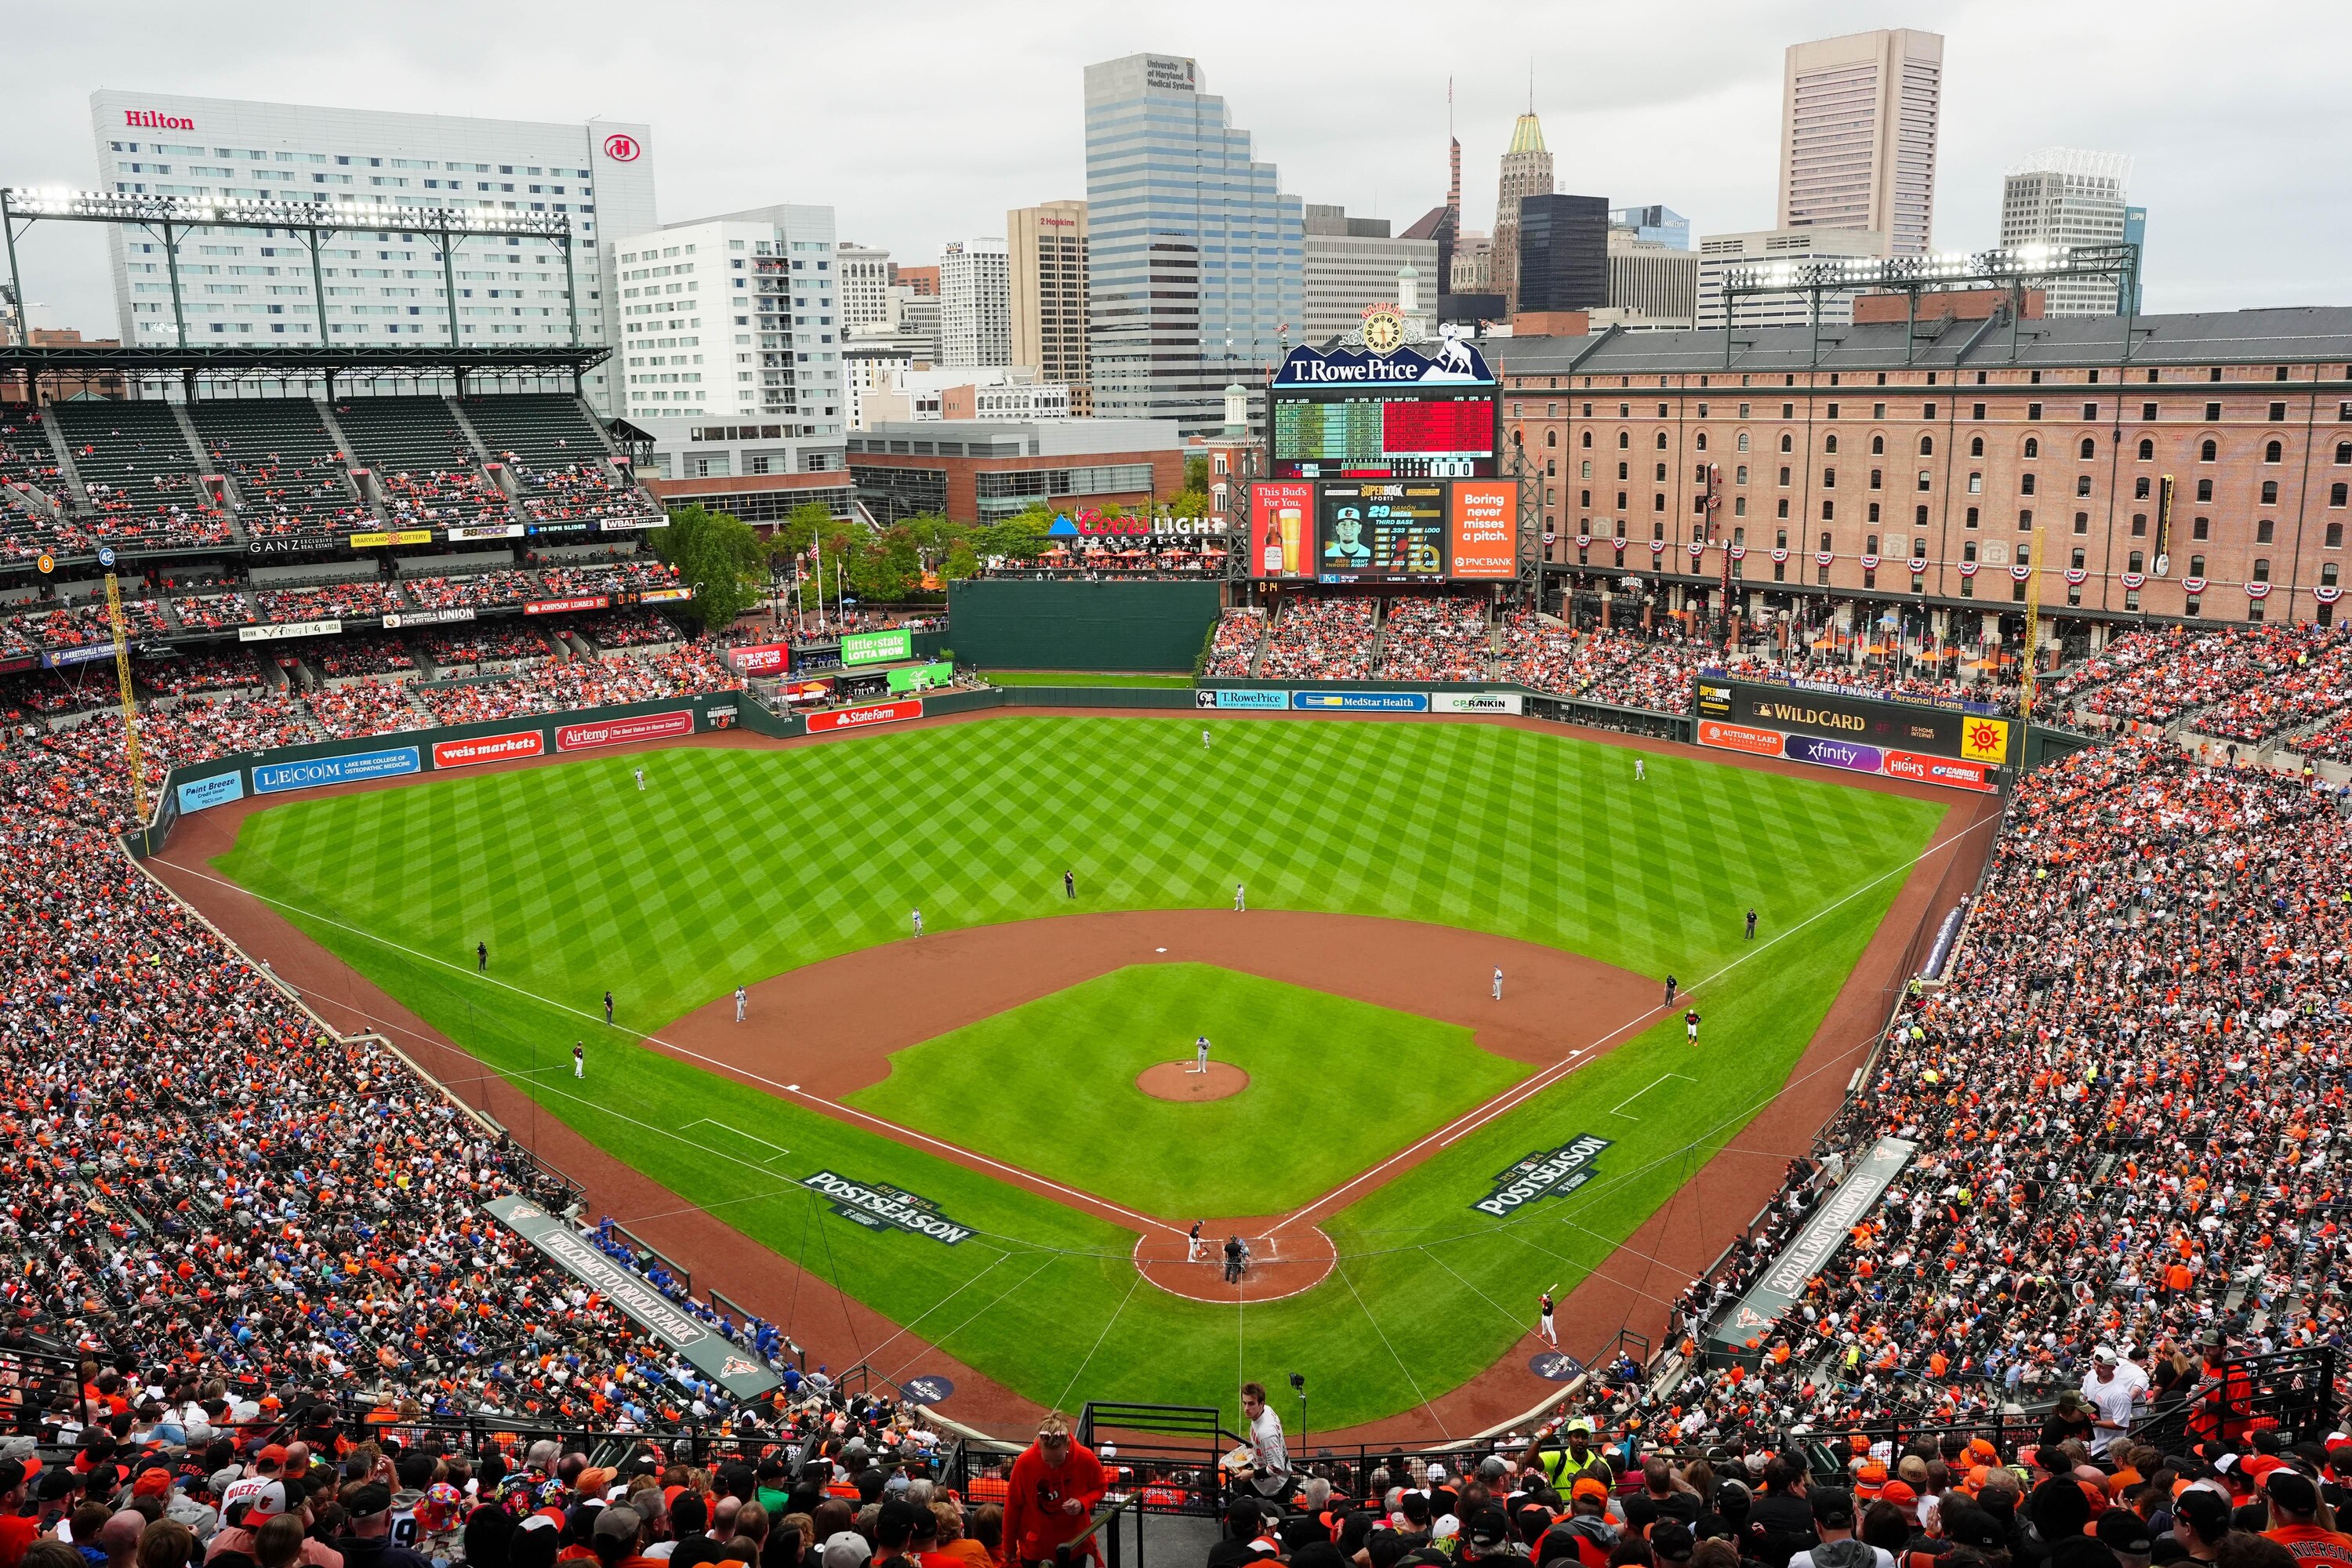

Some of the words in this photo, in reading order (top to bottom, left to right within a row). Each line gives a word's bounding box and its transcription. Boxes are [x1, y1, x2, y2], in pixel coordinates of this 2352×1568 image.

[1147, 60, 1178, 72] University
[1156, 70, 1184, 80] Maryland
[1148, 78, 1171, 89] Medical
[1172, 81, 1194, 91] System
[125, 111, 194, 130] Hilton
[1046, 218, 1075, 227] Hopkins
[1436, 463, 1439, 476] 1
[1449, 463, 1455, 476] 0
[1463, 463, 1469, 476] 0
[1258, 488, 1279, 496] This
[1282, 487, 1307, 496] Bud's
[1361, 484, 1405, 497] SUPERBOOK
[1264, 498, 1279, 506] For
[1281, 498, 1301, 506] You.
[1465, 493, 1504, 506] Boring
[1367, 505, 1391, 517] 29
[607, 518, 636, 528] WBAL
[1078, 508, 1151, 535] Coors
[1155, 517, 1223, 535] LIGHT
[1464, 517, 1504, 528] misses
[1143, 536, 1192, 545] DECK
[1474, 530, 1508, 543] pitch.
[250, 539, 299, 553] GANZ
[101, 552, 113, 561] 42
[43, 560, 49, 569] 8
[1260, 582, 1277, 592] 0:14
[618, 593, 637, 604] 0:14
[541, 602, 569, 611] JOHNSON
[438, 608, 474, 620] UNION
[848, 638, 873, 651] little
[877, 636, 904, 647] state
[62, 646, 97, 660] JARRETTSVILLE
[755, 650, 780, 659] DEATHS
[848, 649, 878, 660] LOTTA
[879, 647, 904, 656] WOW
[1700, 685, 1732, 701] SUPERBOOK
[1726, 670, 1762, 683] Personal
[1764, 675, 1790, 687] Loans
[1795, 680, 1839, 693] MARINER
[1841, 685, 1884, 699] FINANCE
[1891, 691, 1932, 706] Personal
[1934, 697, 1963, 710] Loans
[1345, 698, 1381, 706] MedStar
[1384, 699, 1414, 707] Health
[707, 707, 738, 718] CHAMPIONS
[566, 728, 608, 743] Airtemp
[1722, 730, 1756, 741] AUTUMN
[1757, 735, 1777, 745] LAKE
[442, 746, 476, 759] weis
[477, 738, 535, 754] markets
[1808, 742, 1857, 765] xfinity
[373, 756, 397, 764] COLLEGE
[344, 764, 383, 775] OSTEOPATHIC
[383, 760, 411, 769] MEDICINE
[1891, 760, 1925, 777] HIGH'S
[1946, 768, 1980, 778] CARROLL
[186, 785, 206, 796] Point
[209, 778, 235, 790] Breeze
[202, 796, 223, 804] PBCU.com
[1500, 1172, 1516, 1181] 20
[1528, 1153, 1544, 1163] 24
[1477, 1137, 1608, 1215] POSTSEASON
[877, 1185, 895, 1193] 20
[914, 1201, 934, 1210] 24
[1821, 1178, 1877, 1229] CHAMPIONS
[804, 1172, 970, 1243] POSTSEASON
[1800, 1225, 1836, 1254] EAST
[1791, 1252, 1816, 1267] AL
[1772, 1262, 1806, 1290] 2023
[546, 1233, 604, 1276] WELCOME
[597, 1269, 622, 1287] TO
[612, 1283, 666, 1319] ORIOLE
[653, 1312, 699, 1343] PARK
[2288, 1541, 2352, 1565] NDERSON
